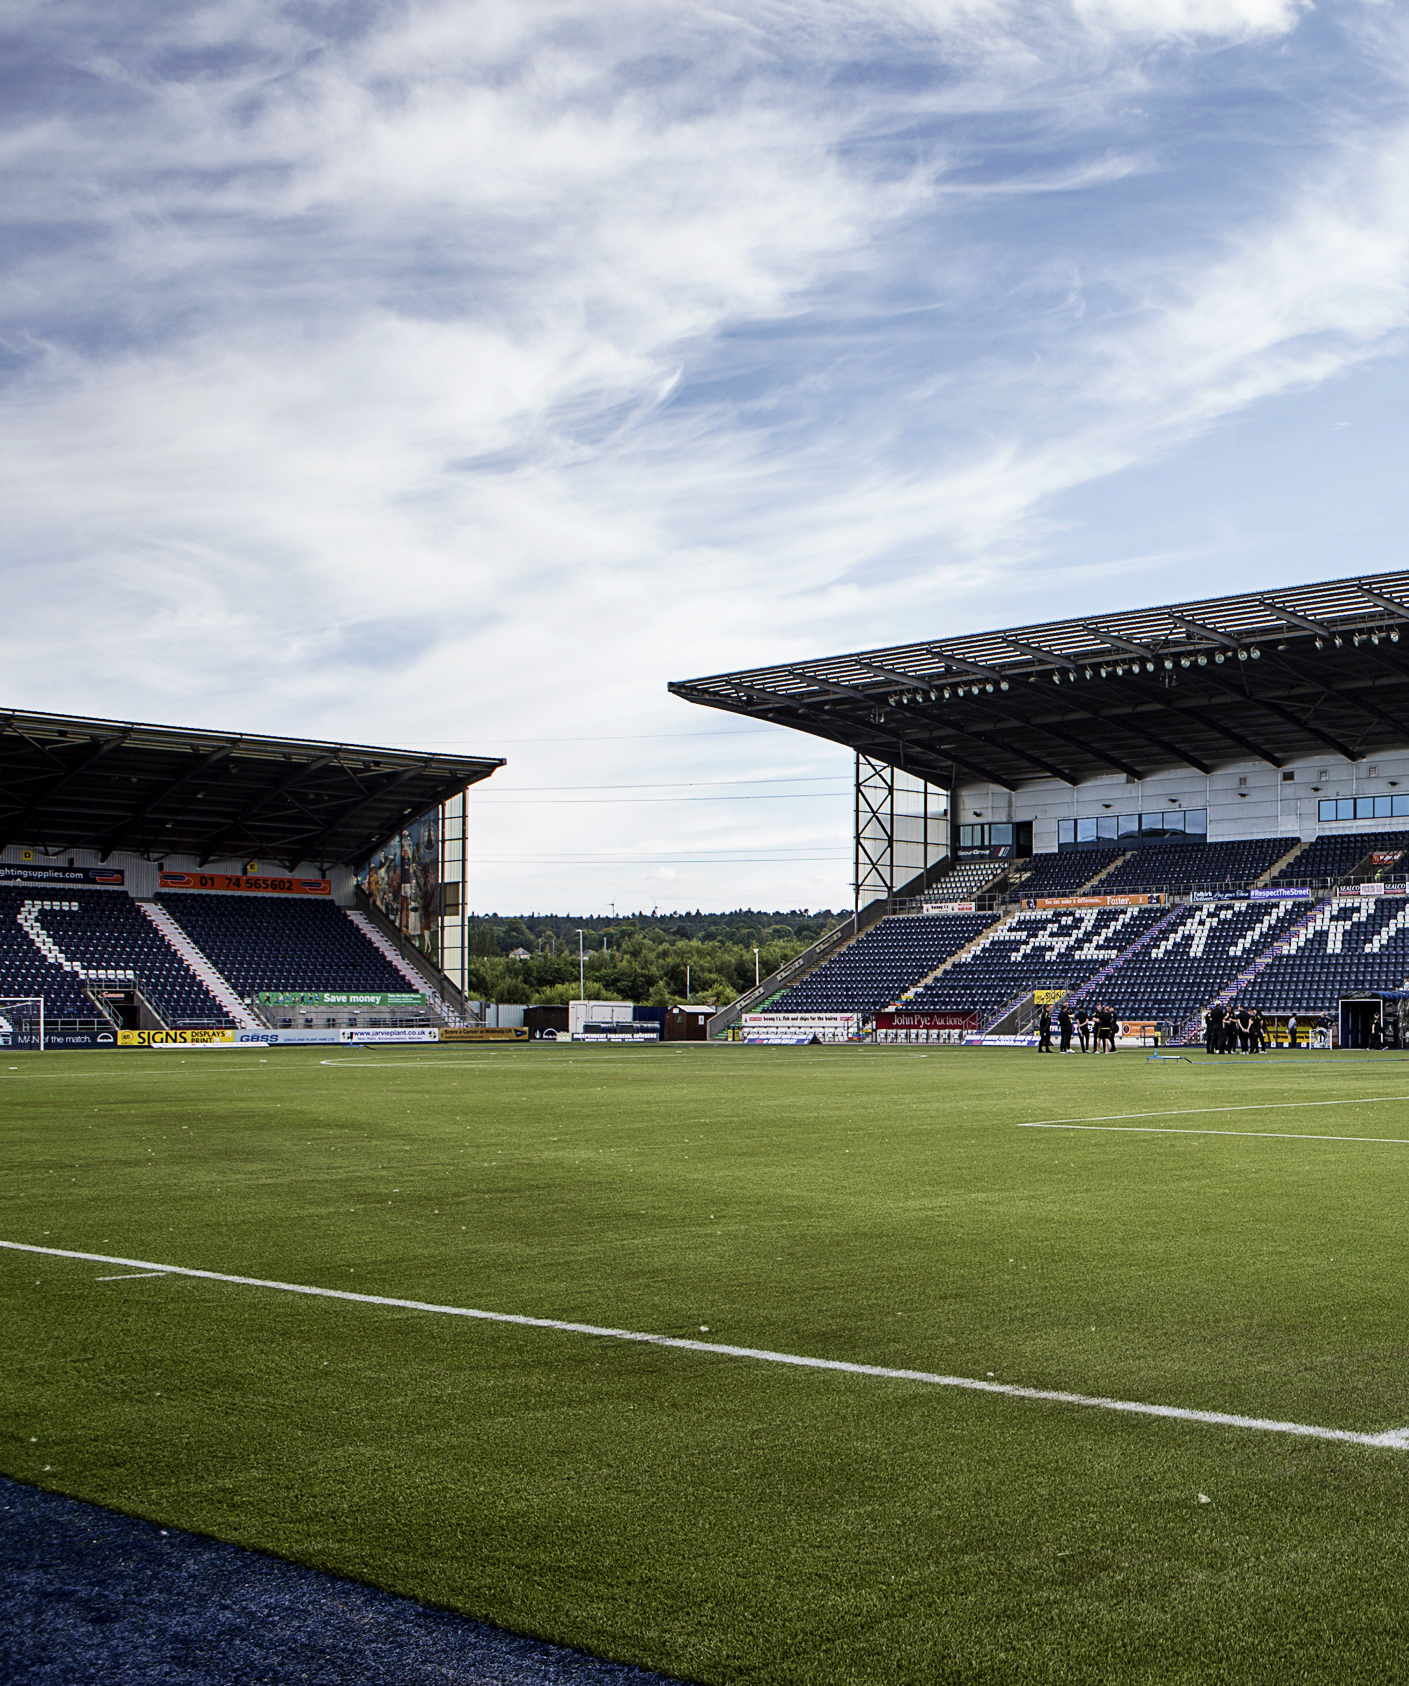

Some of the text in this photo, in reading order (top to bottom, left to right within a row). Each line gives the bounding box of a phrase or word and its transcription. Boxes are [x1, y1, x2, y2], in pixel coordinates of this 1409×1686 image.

[24, 851, 31, 859] D
[1251, 887, 1309, 898] #RespectTheStreet
[1107, 896, 1132, 905] Foster.
[324, 994, 381, 1005] Save money
[892, 1015, 962, 1028] John Pye Auctions
[51, 1035, 63, 1043] the
[65, 1035, 92, 1043] match.
[138, 1032, 187, 1044] SIGNS
